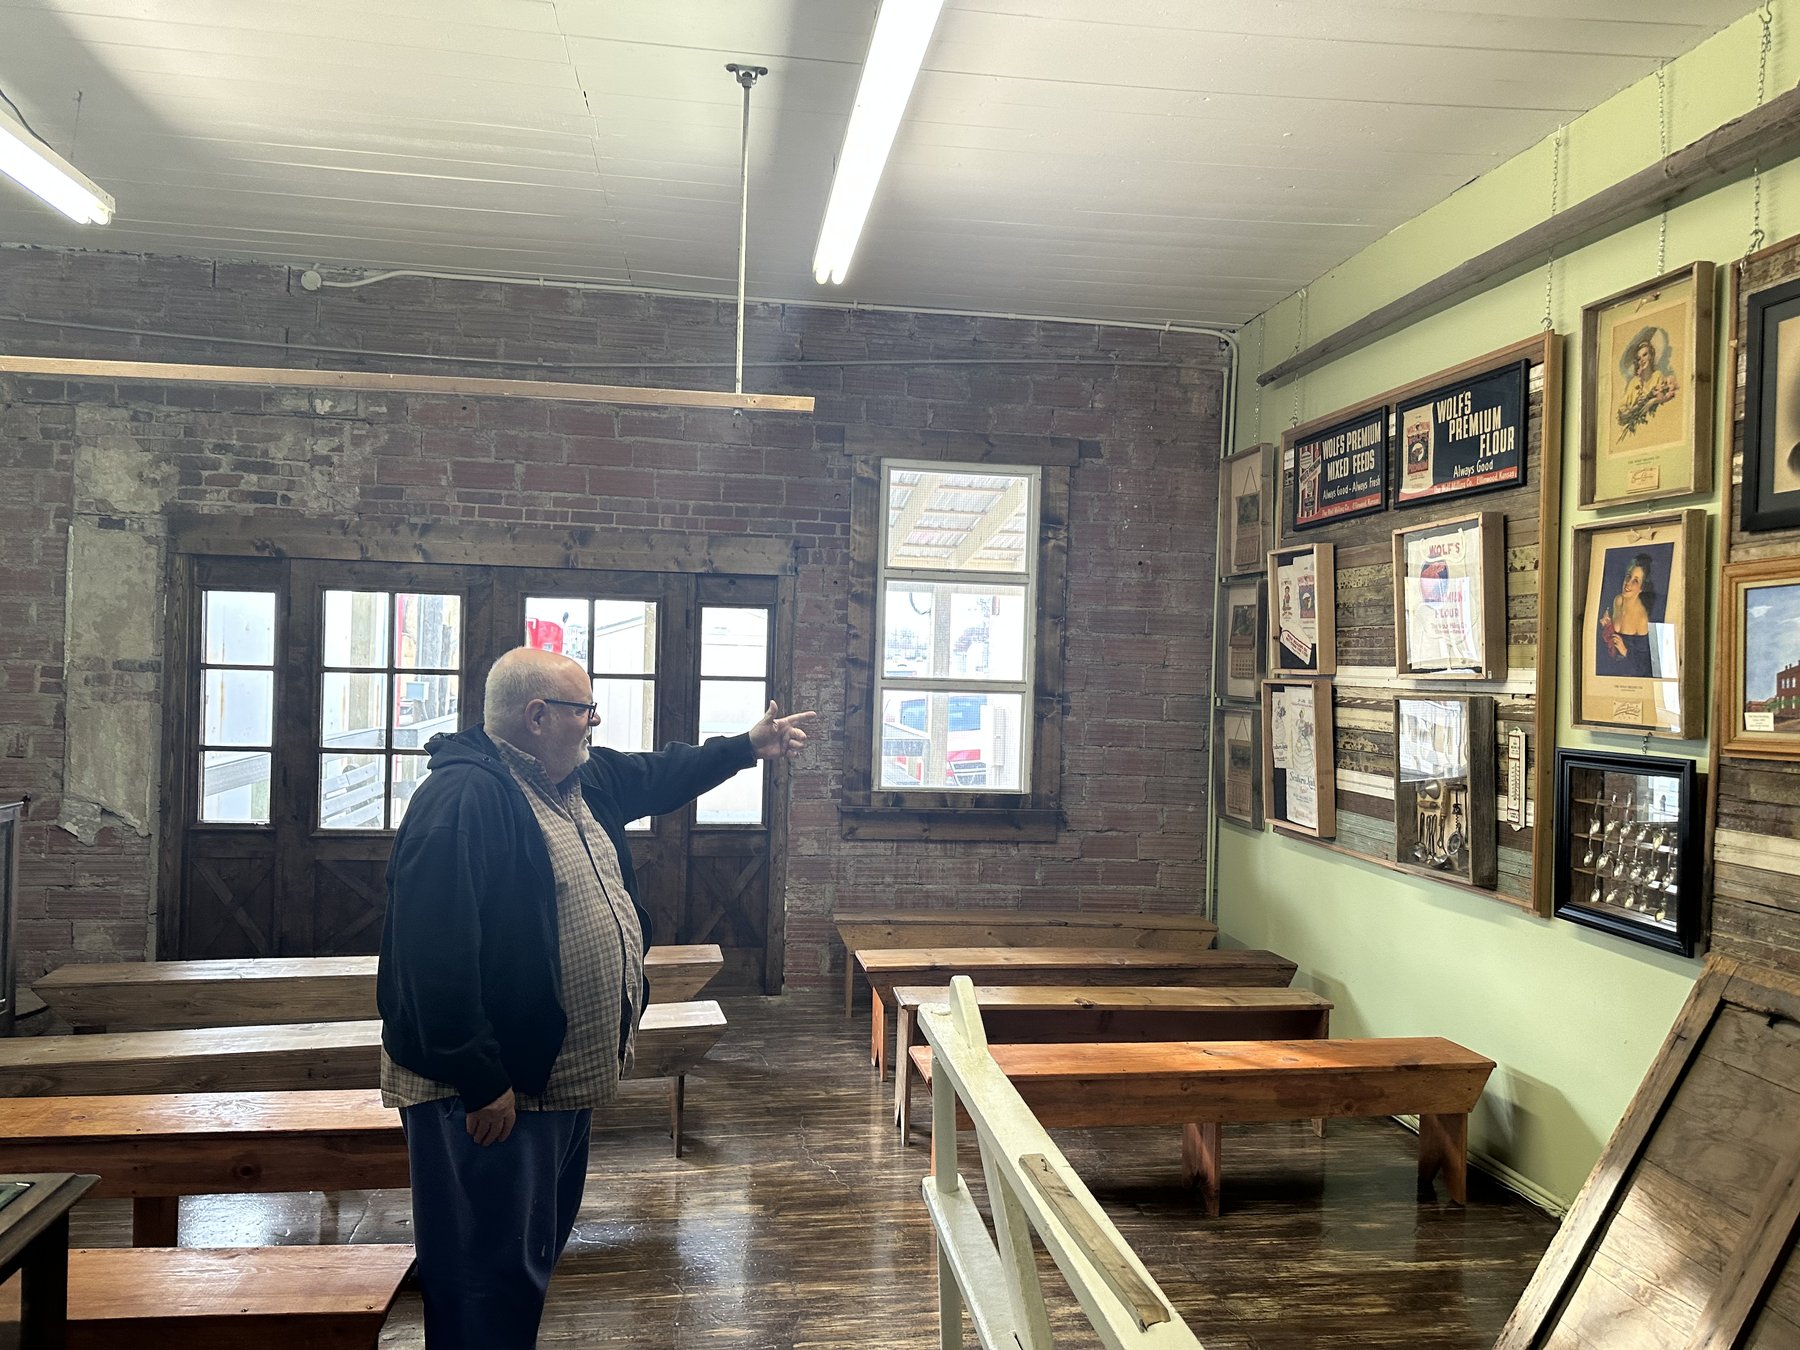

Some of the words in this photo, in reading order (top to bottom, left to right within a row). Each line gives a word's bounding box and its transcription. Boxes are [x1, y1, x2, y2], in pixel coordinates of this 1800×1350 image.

[1346, 420, 1381, 452] PREMIUM
[1448, 405, 1502, 443] PREMIUM
[1480, 425, 1515, 458] FLOUR
[1327, 457, 1349, 482] MIXED
[1352, 449, 1375, 475] FEEDS
[1453, 464, 1475, 478] Always
[1476, 459, 1494, 473] Good
[1428, 542, 1461, 557] WOLF'S
[1434, 607, 1460, 619] FLOUR
